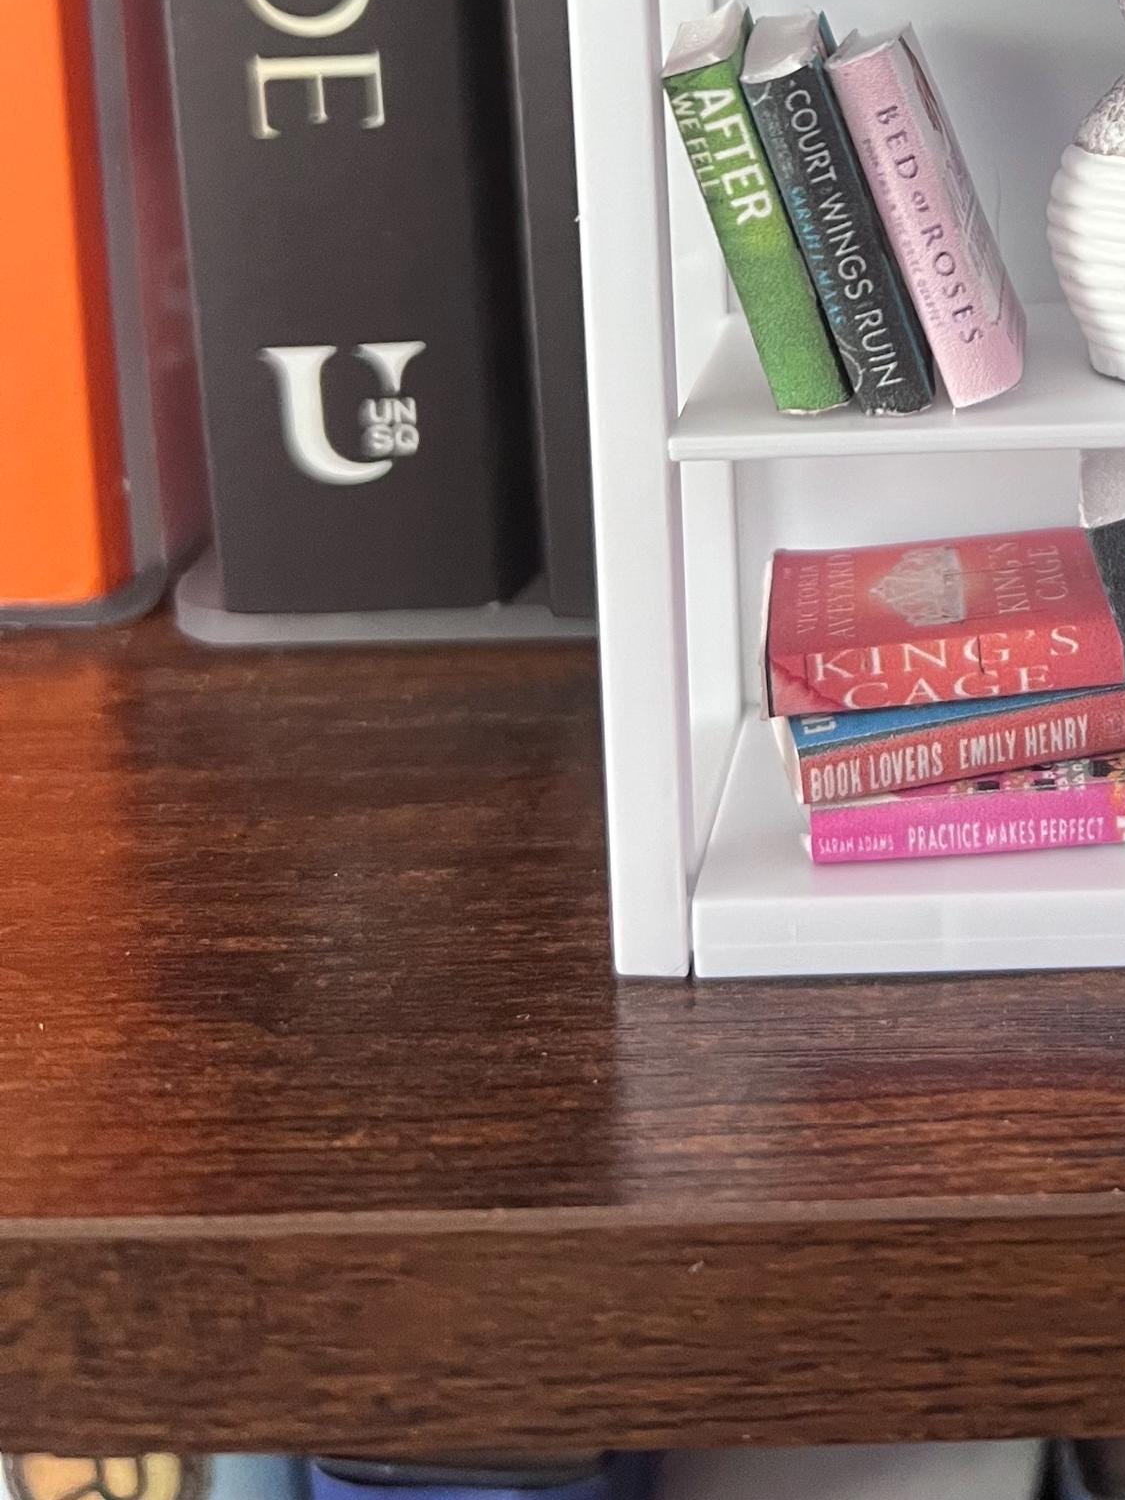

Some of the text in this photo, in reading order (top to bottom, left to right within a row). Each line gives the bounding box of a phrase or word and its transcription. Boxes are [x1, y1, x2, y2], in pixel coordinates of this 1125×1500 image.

[671, 91, 701, 134] WE
[691, 88, 773, 226] AFTER
[785, 89, 838, 184] COURT
[819, 191, 874, 301] WINGS
[854, 307, 904, 389] RUIN
[876, 105, 919, 180] BED
[921, 223, 985, 345] ROSES
[257, 339, 429, 487] U
[359, 396, 418, 426] UN
[1027, 544, 1069, 600] CAGE
[813, 625, 1081, 683] KING'S
[843, 663, 1055, 711] CAGE
[810, 762, 862, 802] BOOK
[869, 742, 944, 796] LOVERS
[958, 730, 1017, 770] EMILY
[1023, 714, 1089, 758] HENRY
[818, 816, 1105, 855] SARAH ADAMS PRACTICE MAKES PERFECT
